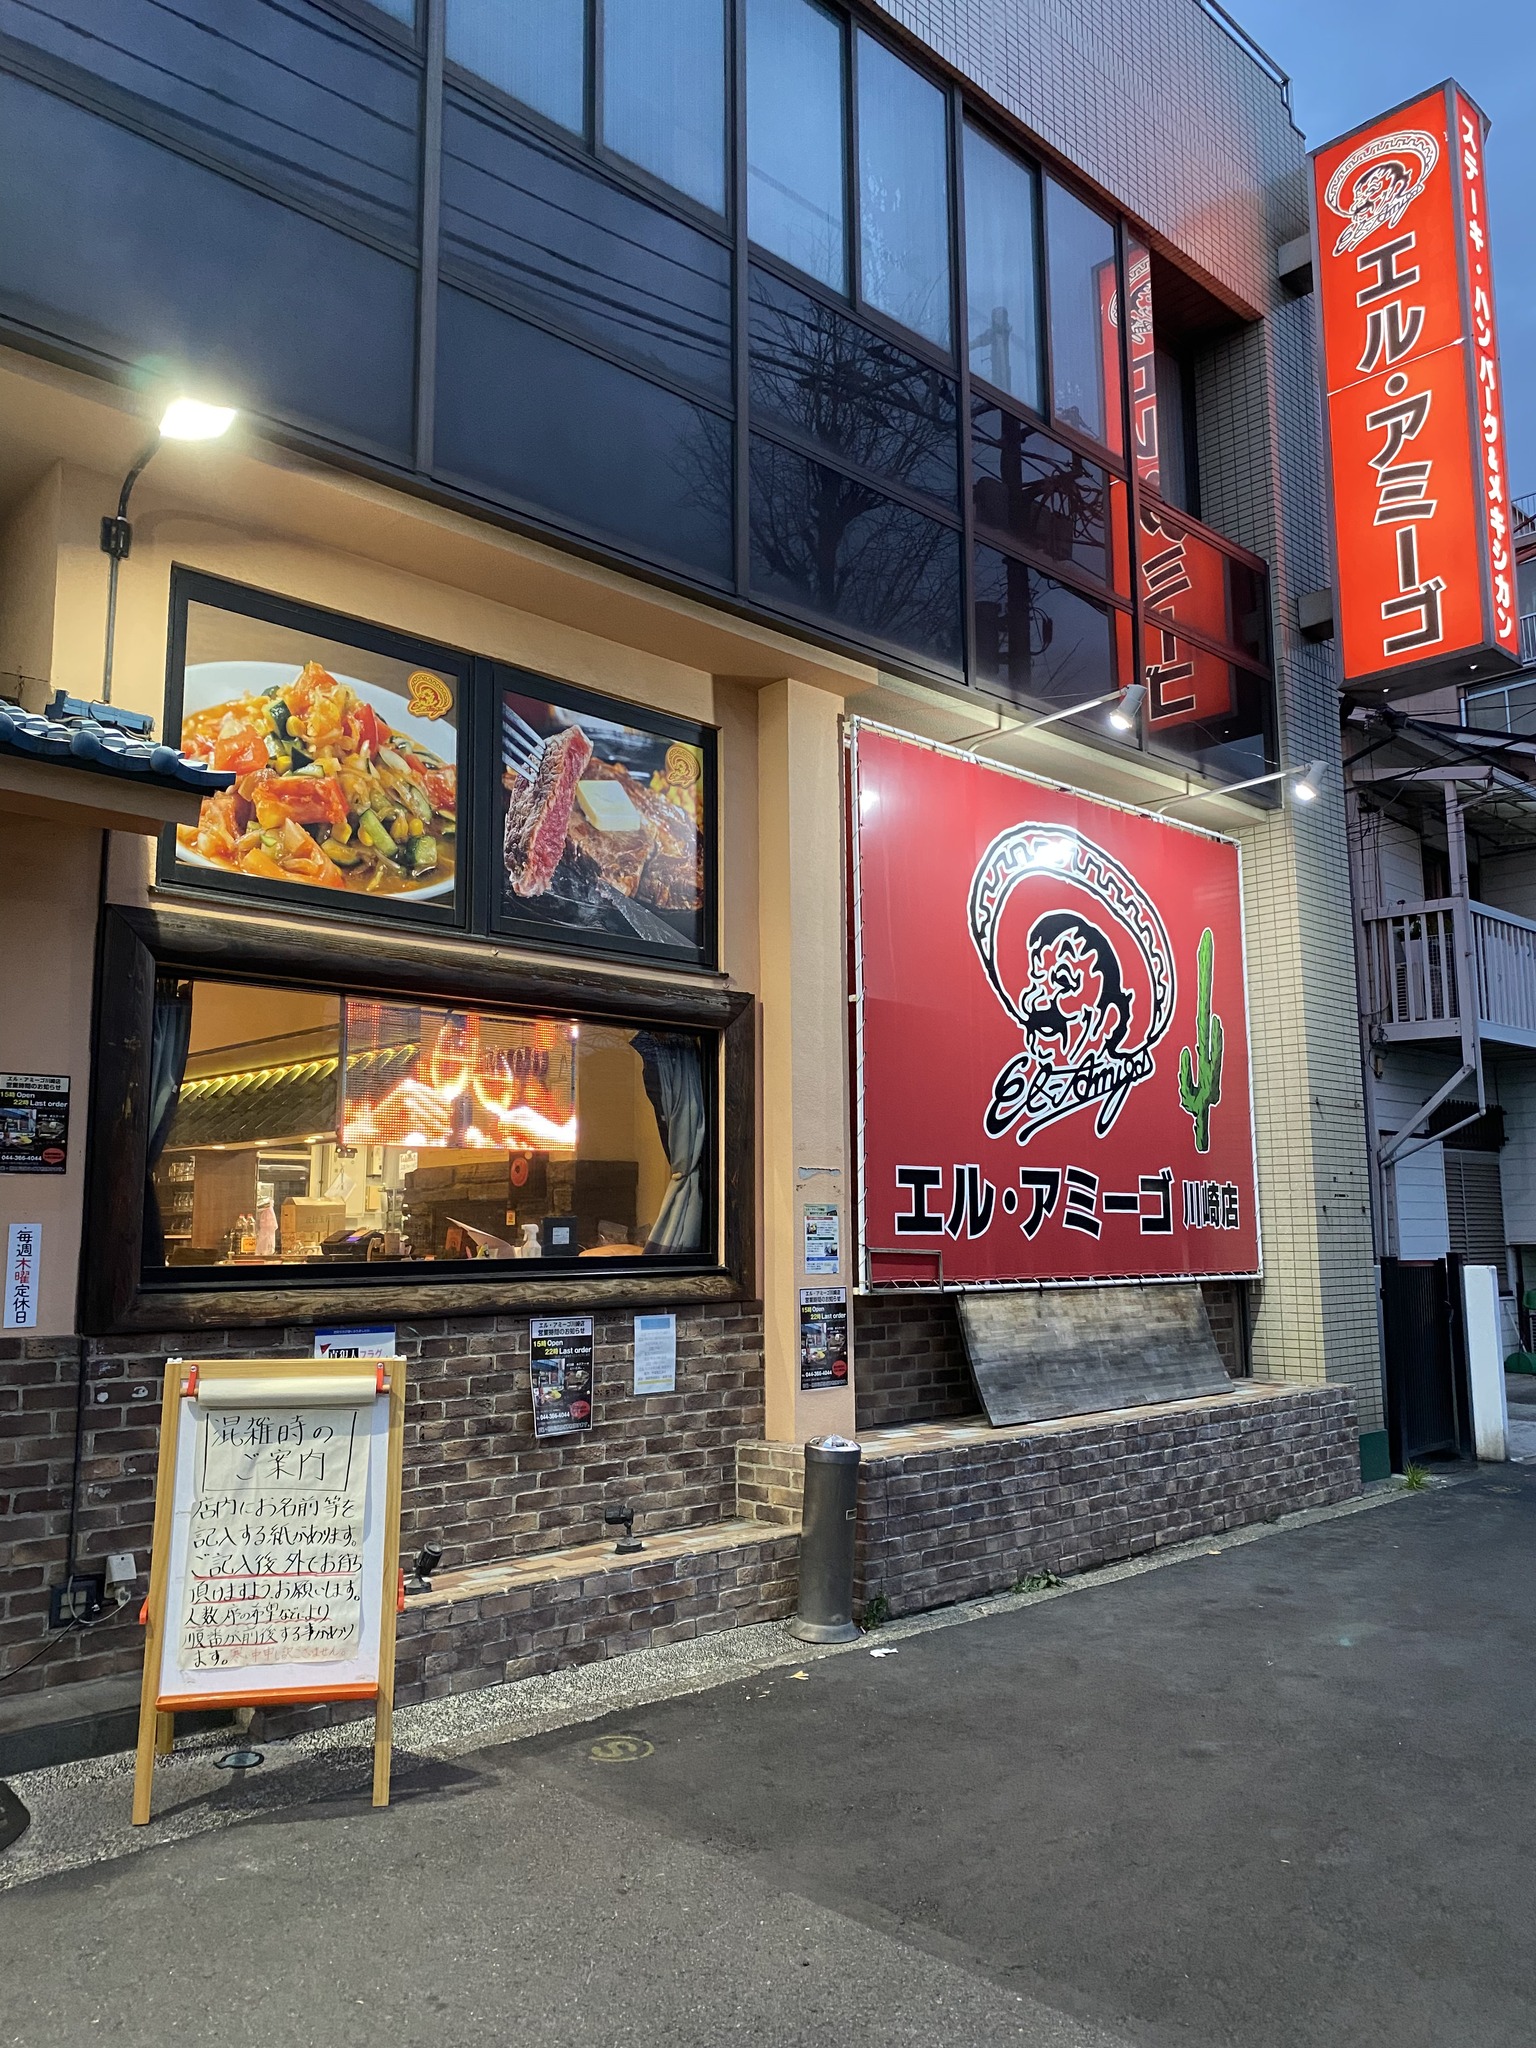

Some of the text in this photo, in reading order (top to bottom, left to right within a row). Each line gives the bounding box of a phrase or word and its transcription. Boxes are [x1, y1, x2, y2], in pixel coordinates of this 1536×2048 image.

[1356, 231, 1447, 657] エル・アミーゴ
[16, 1091, 35, 1099] Open
[895, 1163, 1241, 1241] エル・アミーゴ 川崎店
[13, 1229, 33, 1324] 毎週木曜定休日
[546, 1339, 564, 1348] Open
[558, 1346, 574, 1355] Last
[574, 1345, 592, 1354] order
[211, 1414, 334, 1447] 混雑時の
[236, 1448, 326, 1482] ご案内
[191, 1496, 356, 1519] 店内にお名前等を
[192, 1523, 358, 1549] 記入する紙があります。
